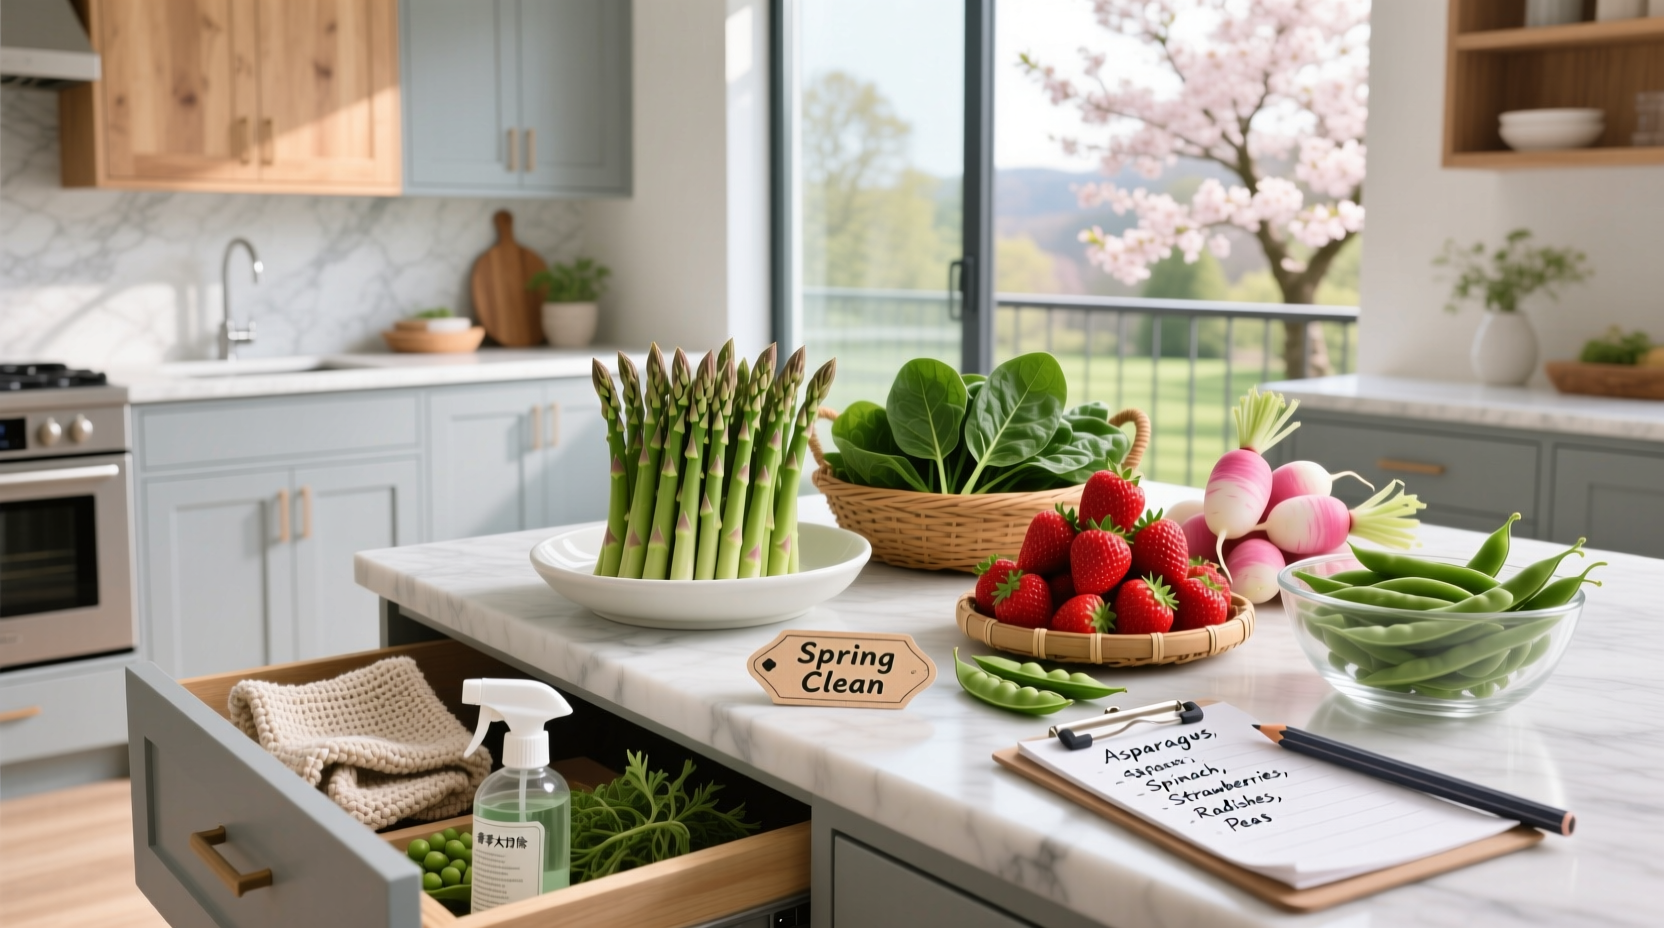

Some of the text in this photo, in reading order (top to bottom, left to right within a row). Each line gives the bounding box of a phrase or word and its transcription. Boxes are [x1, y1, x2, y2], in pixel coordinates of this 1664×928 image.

[797, 641, 895, 675] Spring
[801, 670, 884, 695] Clean
[1104, 728, 1217, 764] Asparagus,
[1146, 763, 1227, 793] Spinach,
[1168, 769, 1288, 806] Strawberries,
[1193, 793, 1282, 819] Radishes,
[1223, 812, 1272, 832] Peas
